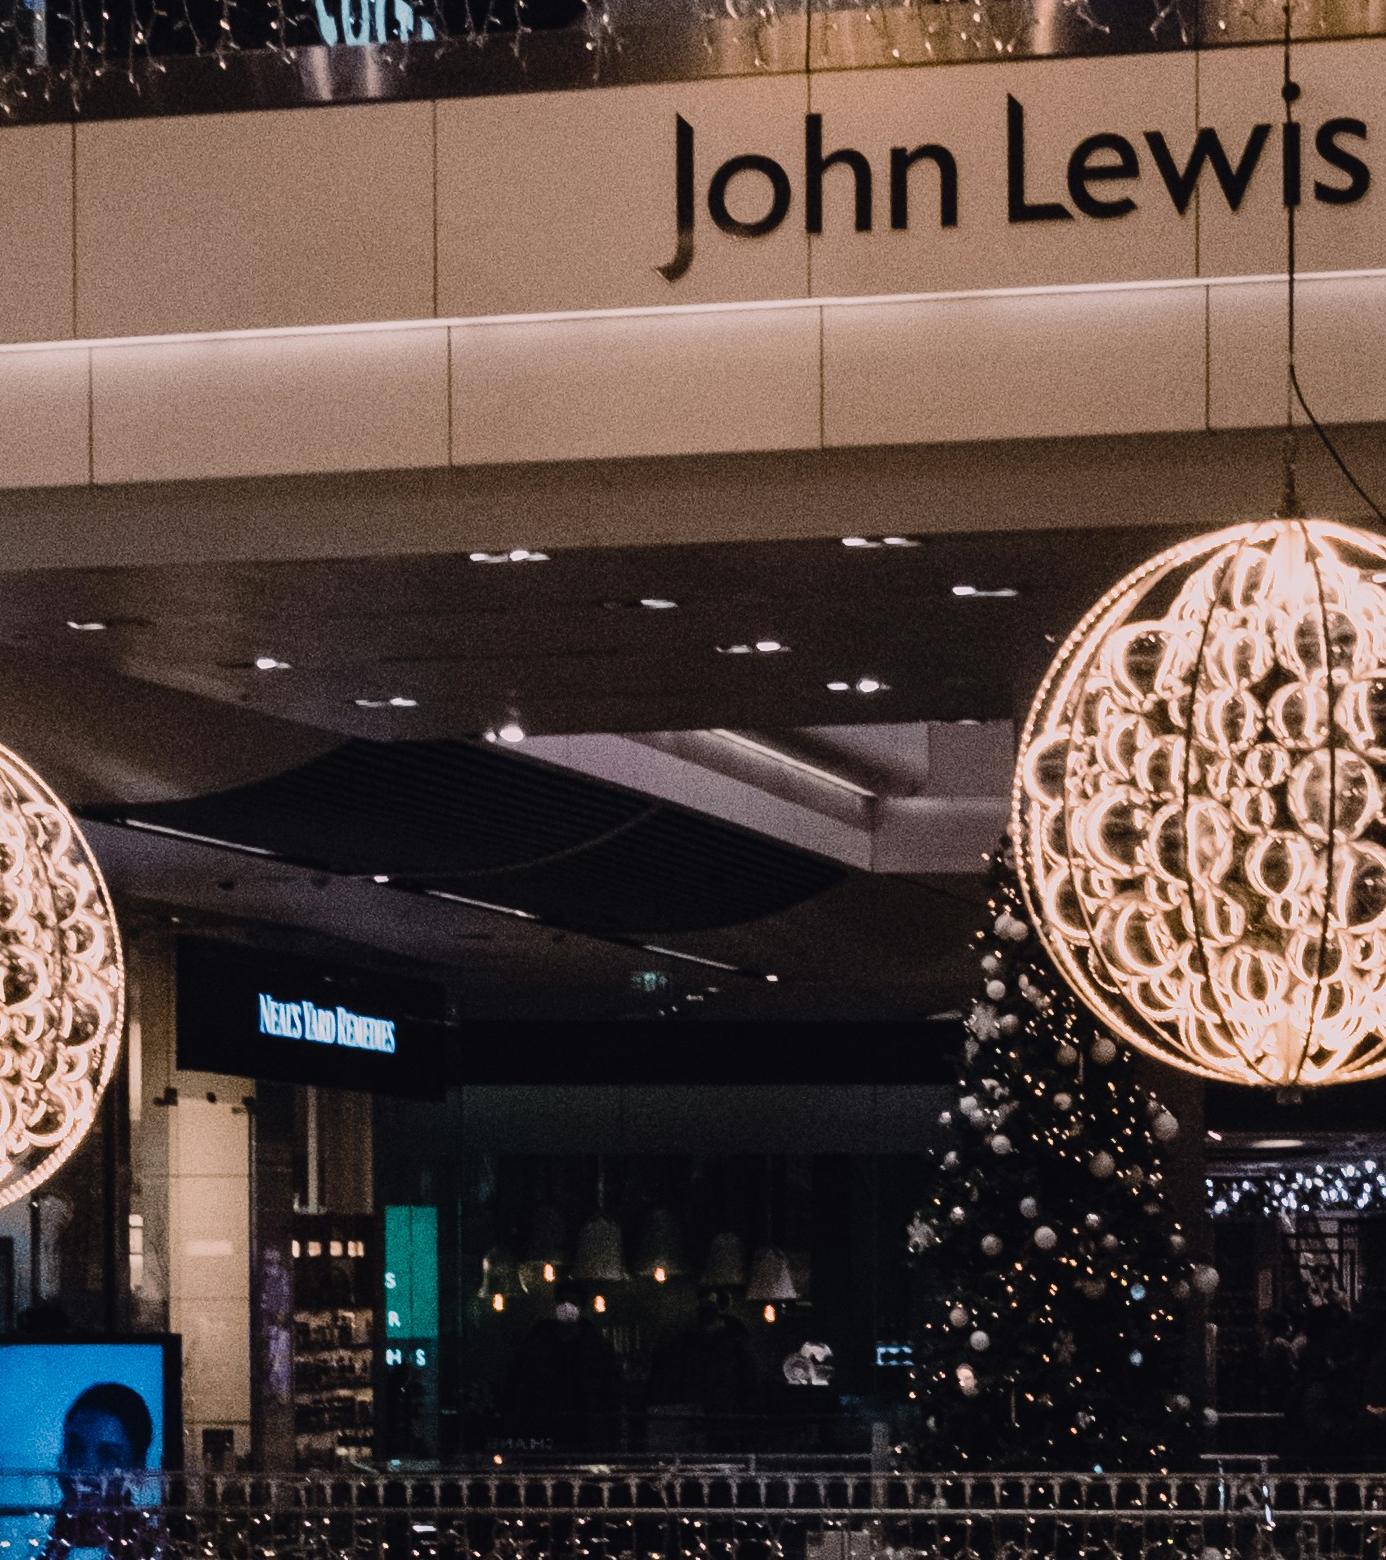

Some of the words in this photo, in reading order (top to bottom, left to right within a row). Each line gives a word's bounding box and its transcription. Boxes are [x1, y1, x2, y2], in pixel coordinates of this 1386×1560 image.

[654, 111, 959, 283] John
[1008, 81, 1372, 223] Lewis
[301, 1000, 337, 1045] YARD
[335, 1006, 396, 1055] REMEDIES
